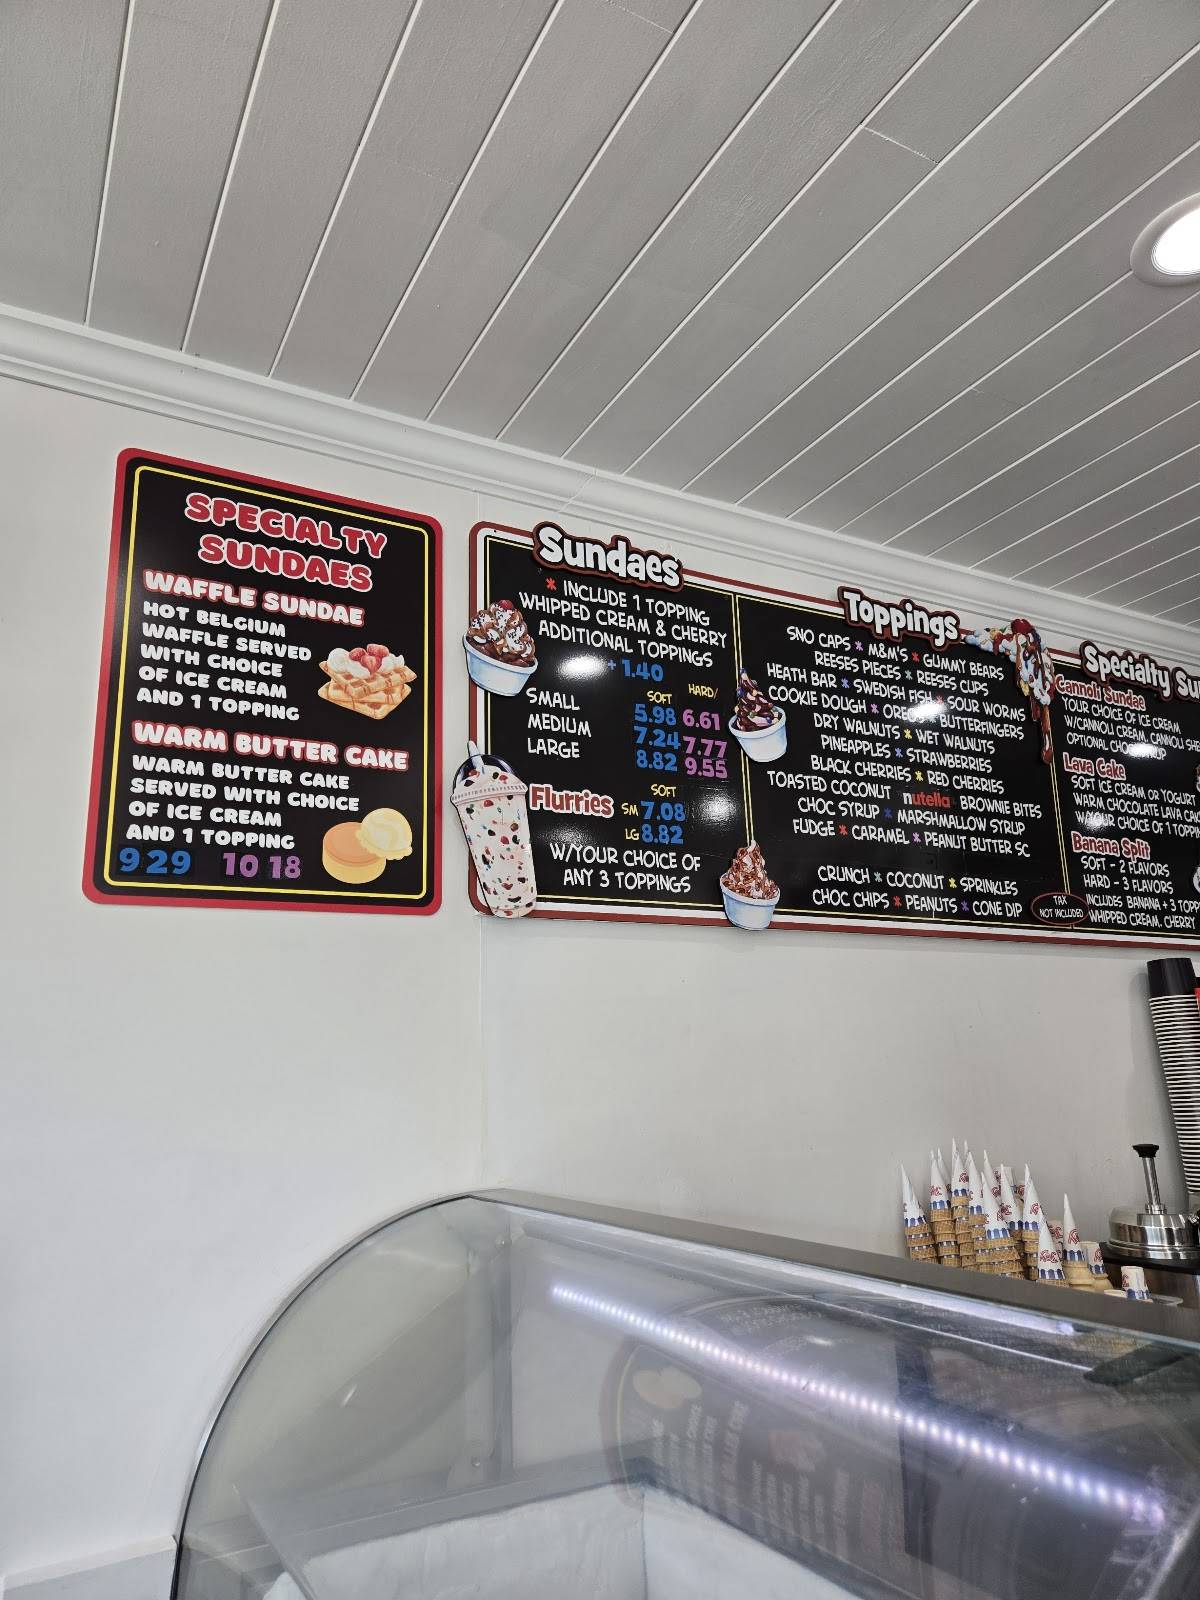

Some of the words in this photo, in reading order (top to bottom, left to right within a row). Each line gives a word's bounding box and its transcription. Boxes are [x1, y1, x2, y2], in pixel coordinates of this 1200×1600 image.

[184, 492, 388, 559] SPECIALTY
[197, 533, 374, 593] SUNDAES
[538, 526, 680, 587] Sundaes
[142, 568, 258, 609] WAFFLE
[261, 591, 366, 628] SUNDAE
[563, 579, 628, 608] INCLUDE
[632, 594, 641, 611] 1
[645, 598, 710, 627] TOPPING
[142, 600, 190, 622] HOT
[196, 609, 286, 638] BELGIUM
[518, 591, 591, 621] WHIPPED
[595, 609, 651, 635] CREAM
[655, 619, 667, 637] &
[671, 624, 727, 649] CHERRY
[843, 591, 958, 647] Toppings
[141, 621, 230, 649] WAFFLE
[235, 637, 312, 661] SERVED
[538, 619, 634, 654] ADDITIONAL
[637, 639, 713, 668] TOPPINGS
[786, 625, 815, 645] SNO
[818, 632, 852, 652] CAPS
[868, 642, 909, 663] M&M'S
[922, 653, 967, 674] GUMMY
[969, 661, 1005, 681] BEARS
[140, 643, 200, 666] WITH
[207, 653, 283, 678] CHOICE
[621, 659, 664, 682] 1.40
[814, 650, 860, 673] REESES
[861, 659, 902, 681] PIECES
[916, 669, 958, 691] REESES
[959, 679, 989, 697] CUPS
[1084, 646, 1171, 697] Specialty
[138, 665, 169, 683] OF
[175, 670, 211, 689] ICE
[216, 676, 287, 699] CREAM
[646, 690, 674, 705] SOFT
[766, 662, 808, 684] HEATH
[810, 670, 838, 689] BAR
[852, 678, 906, 701] SWEDISH
[908, 689, 935, 707] FISH
[946, 695, 980, 713] SOUR
[982, 701, 1026, 722] WORMS
[1053, 673, 1102, 702] Cannoli
[1102, 685, 1147, 712] Sundae
[136, 687, 184, 707] AND
[190, 694, 202, 709] 1
[208, 696, 300, 721] TOPPING
[525, 687, 581, 711] SMALL
[634, 703, 677, 726] 5.98
[682, 708, 721, 731] 6.61
[768, 685, 818, 706] COOKIE
[820, 692, 867, 714] DOUGH
[938, 711, 1025, 741] BUTTERFINGERS
[1061, 695, 1090, 714] YOUR
[1091, 703, 1124, 721] CHOICE
[1152, 717, 1182, 735] CREAM
[131, 719, 229, 753] WARM
[233, 731, 339, 765] BUTTER
[343, 744, 410, 772] CAKE
[527, 712, 592, 738] MEDIUM
[633, 725, 681, 750] 7.24
[682, 735, 728, 759] 7.77
[813, 712, 840, 731] DRY
[842, 717, 901, 740] WALNUTS
[915, 728, 940, 746] WET
[942, 733, 996, 755] WALNUTS
[132, 754, 205, 777] WARM
[211, 762, 293, 785] BUTTER
[299, 771, 350, 790] CAKE
[527, 737, 581, 758] LARGE
[636, 749, 678, 772] 8.82
[684, 756, 728, 779] 9.55
[820, 734, 891, 759] PINEAPPLES
[906, 747, 993, 774] STRAWBERRIES
[1062, 751, 1096, 777] Lava
[1095, 757, 1127, 781] Cake
[650, 783, 677, 798] SOFT
[810, 754, 852, 775] BLACK
[854, 761, 912, 783] CHERRIES
[926, 770, 950, 787] RED
[952, 774, 1005, 795] CHERRIES
[1070, 774, 1096, 791] SOFT
[1098, 779, 1113, 794] ICE
[1114, 782, 1147, 800] CREAM
[1160, 788, 1196, 807] YOGURT
[129, 777, 217, 800] SERVED
[223, 785, 281, 805] WITH
[287, 791, 360, 812] CHOICE
[529, 783, 615, 819] Flurries
[621, 802, 639, 817] SM
[640, 800, 686, 822] 7.08
[766, 770, 828, 793] TOASTED
[830, 779, 892, 800] COCONUT
[902, 791, 951, 808] nutella
[959, 795, 1011, 815] BROWNIE
[1012, 802, 1043, 819] BITES
[1072, 792, 1106, 810] WARM
[1106, 797, 1160, 817] CHOCOLATE
[1160, 806, 1183, 821] LAVA
[128, 800, 160, 818] OF
[166, 803, 203, 821] ICE
[209, 807, 282, 828] CREAM
[797, 796, 836, 816] CHOC
[837, 800, 880, 820] SYRUP
[897, 808, 987, 832] MARSHMALLOW
[989, 818, 1026, 836] SYRUP
[1117, 815, 1151, 833] CHOICE
[125, 823, 175, 842] AND
[182, 827, 193, 844] 1
[200, 828, 296, 850] TOPPING
[625, 828, 640, 841] LG
[641, 823, 684, 845] 8.82
[792, 817, 836, 837] FUDGE
[851, 824, 911, 845] CARAMEL
[923, 831, 967, 850] PEANUT
[969, 836, 1013, 855] BUTTER
[1014, 841, 1031, 858] SC
[1070, 830, 1121, 858] Banana
[1120, 837, 1151, 863] Split
[549, 842, 619, 864] W/YOUR
[623, 849, 678, 870] CHOICE
[681, 853, 701, 872] OF
[1080, 855, 1106, 871] SOFT
[1127, 859, 1170, 878] FLAVORS
[563, 867, 594, 887] ANY
[599, 869, 610, 888] 3
[614, 871, 692, 894] TOPPINGS
[817, 865, 871, 885] CRUNCH
[886, 871, 945, 890] COCONUT
[959, 876, 1019, 897] SPRINKLES
[1082, 873, 1111, 889] HARD
[1131, 879, 1174, 895] FLAVORS
[812, 888, 851, 907] CHOC
[852, 891, 890, 910] CHIPS
[904, 894, 958, 914] PEANUTS
[972, 900, 1003, 916] CONE
[1004, 902, 1023, 918] DIP
[1039, 908, 1053, 919] NOT
[1054, 908, 1084, 919] INCLUDED
[1052, 894, 1068, 906] TAX
[1085, 893, 1123, 908] INCLUDES
[1126, 895, 1162, 911] BANANA
[1088, 909, 1128, 925] WHIPPED
[1163, 915, 1196, 930] CHERRY
